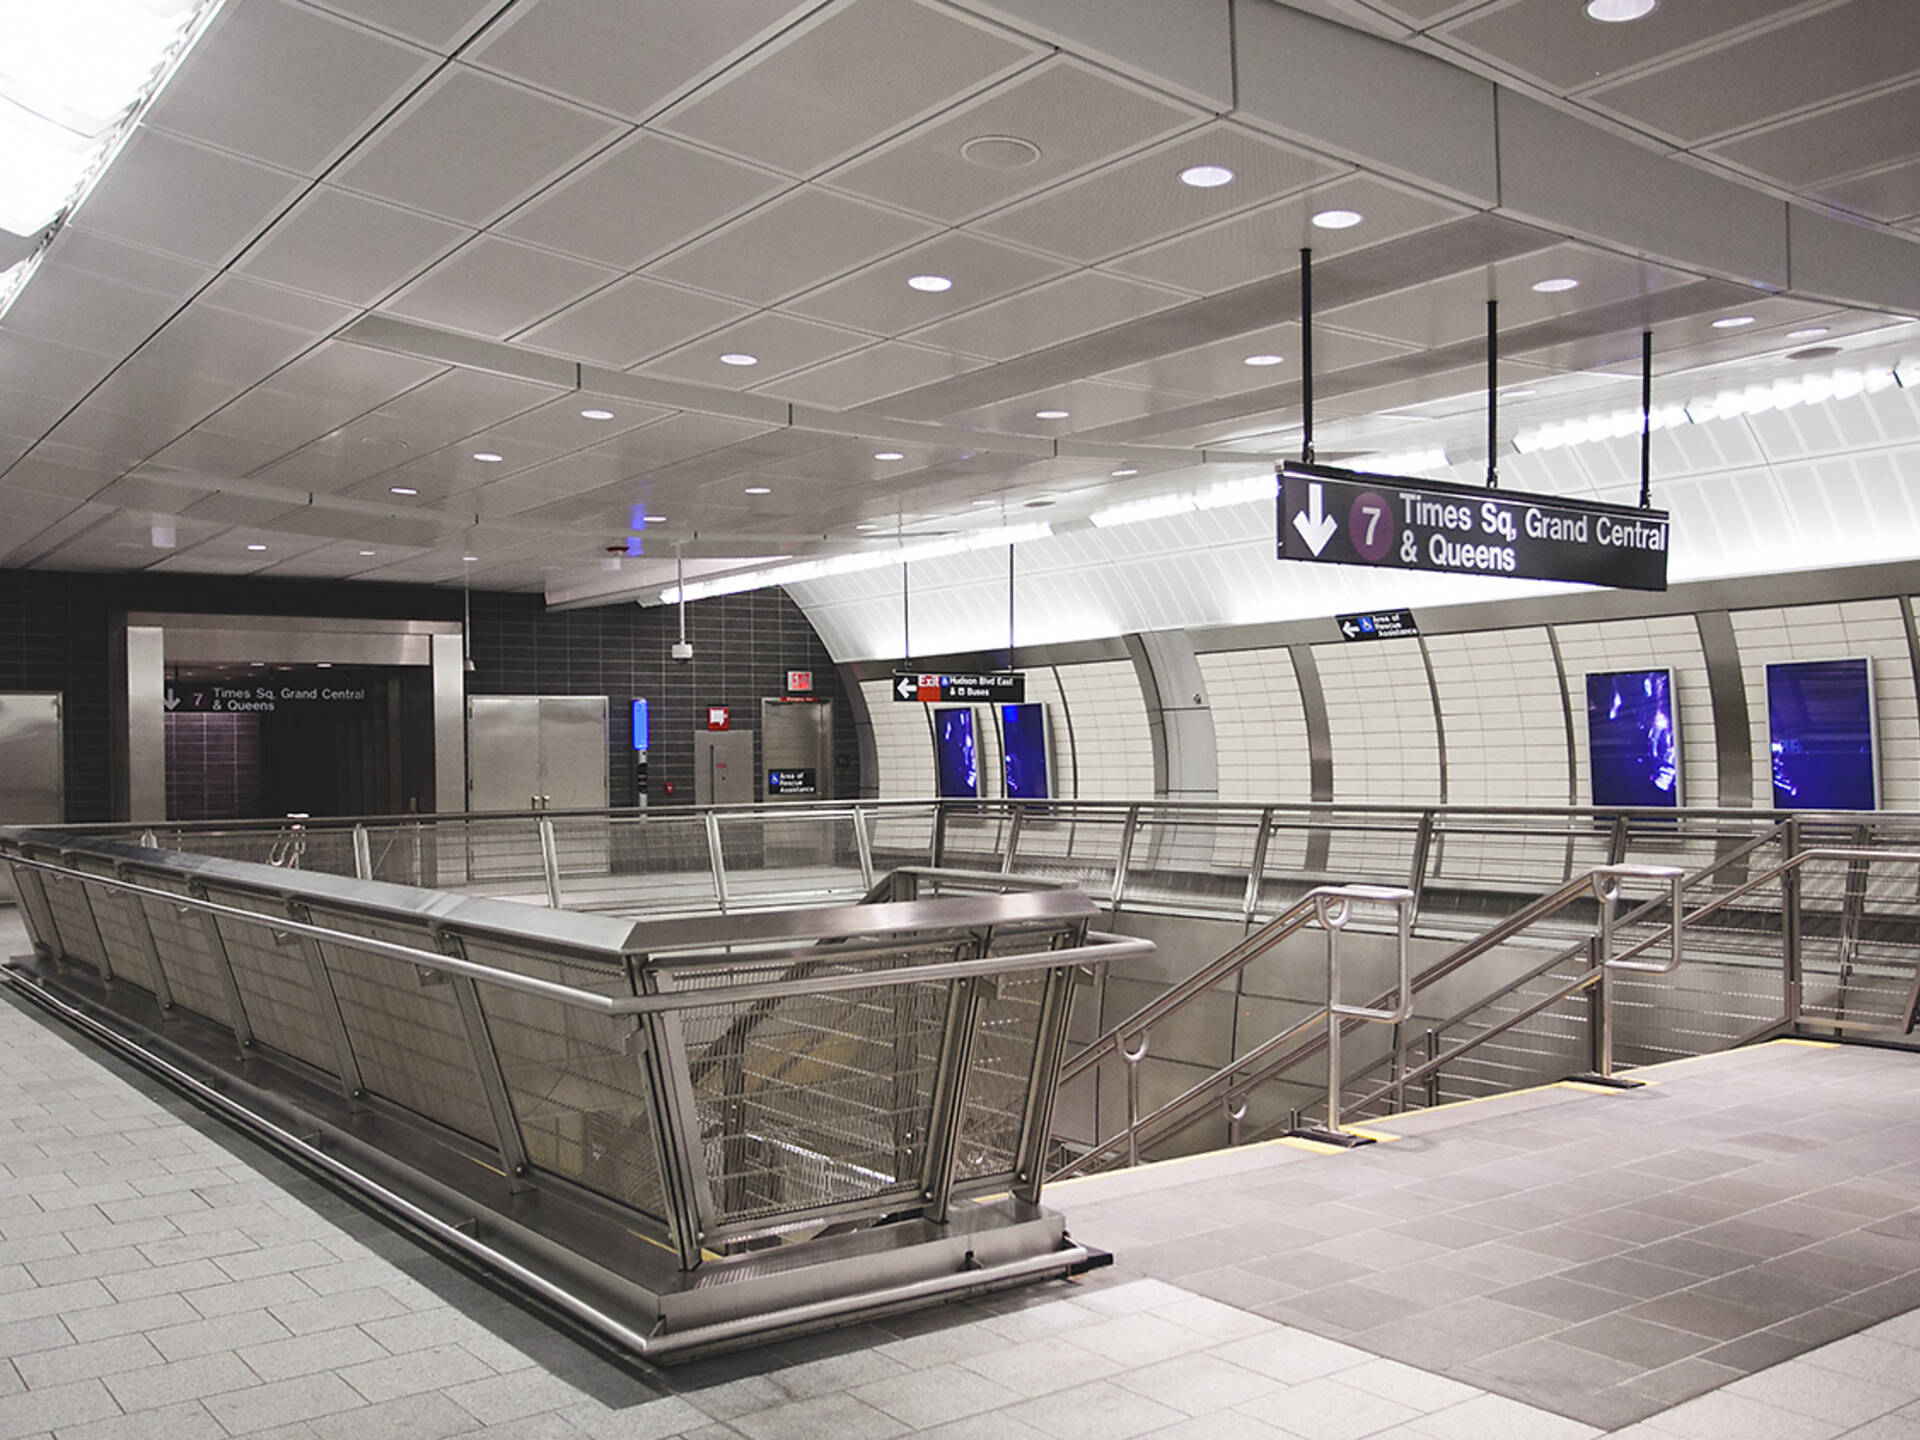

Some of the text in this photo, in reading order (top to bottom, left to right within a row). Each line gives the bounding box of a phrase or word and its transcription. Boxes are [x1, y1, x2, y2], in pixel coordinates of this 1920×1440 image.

[1361, 507, 1383, 546] 7
[1399, 492, 1472, 531] Times
[1524, 508, 1588, 543] Grand
[1595, 517, 1666, 552] Central
[1399, 529, 1516, 572] & Queens
[918, 674, 939, 687] Exit
[950, 676, 977, 686] Hudson
[979, 676, 995, 686] Blvd
[212, 687, 251, 698] Times
[281, 687, 317, 699] Grand
[321, 688, 365, 700] Central
[967, 687, 990, 696] Buses
[193, 692, 203, 706] 7
[212, 699, 275, 711] & Queens
